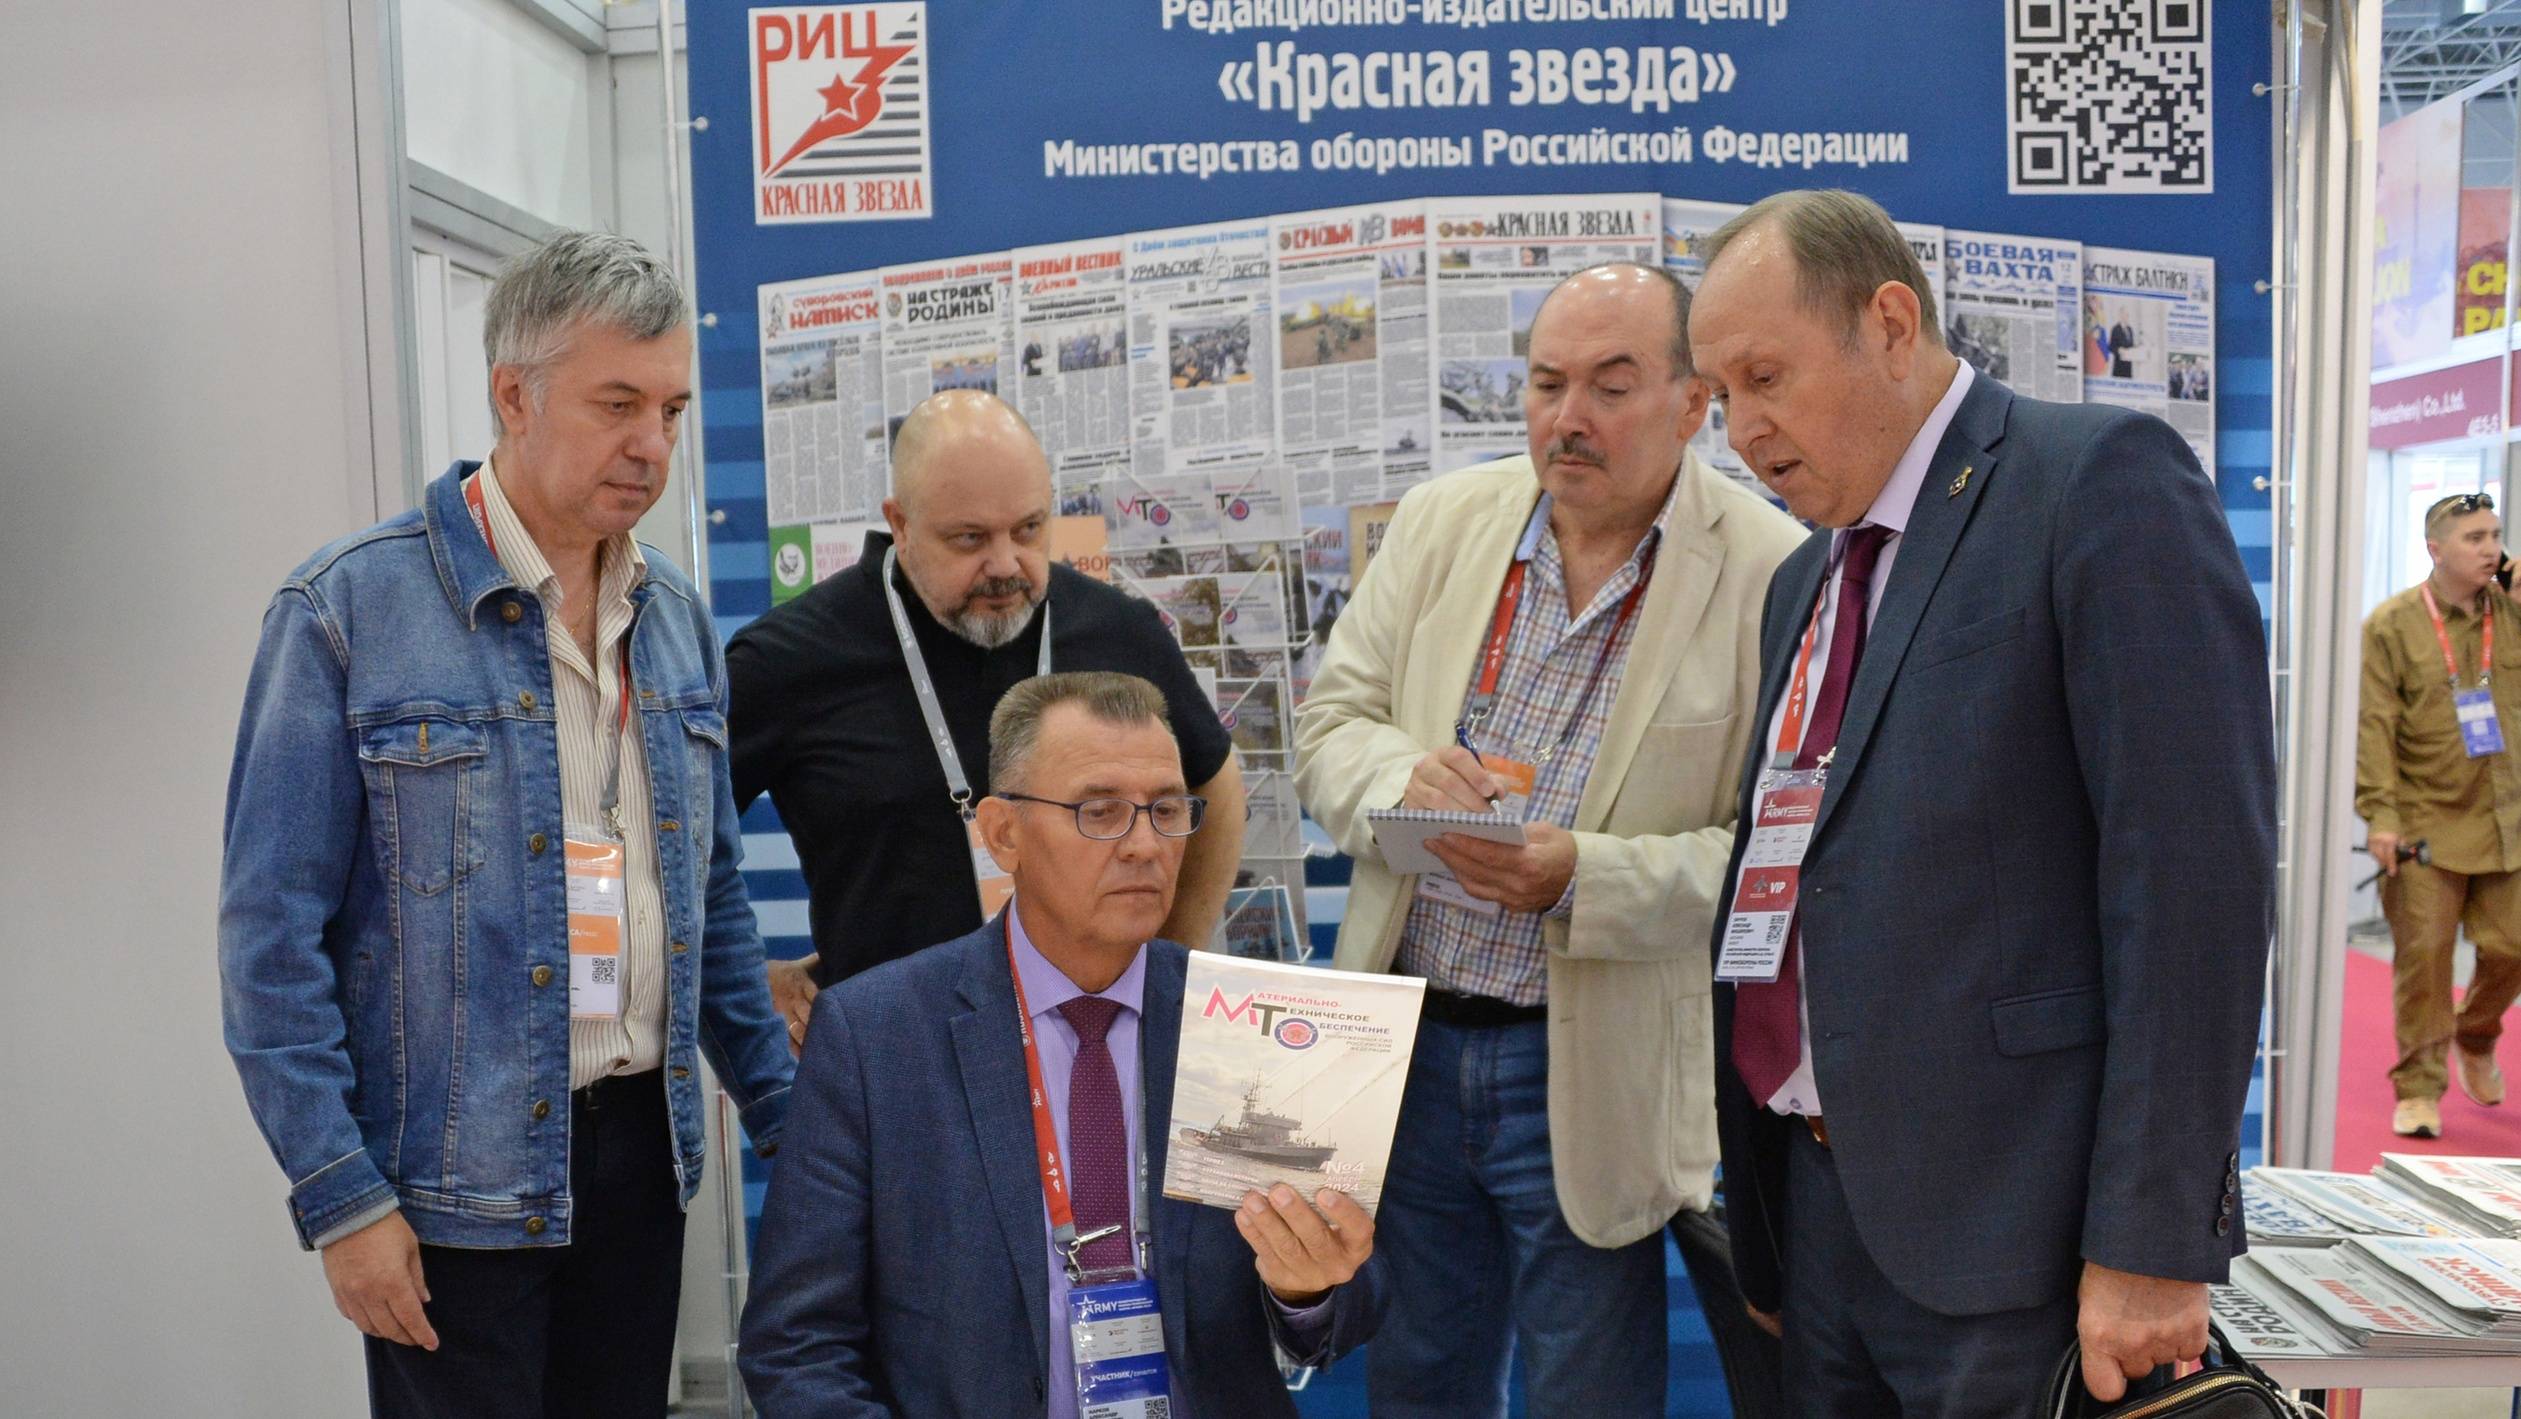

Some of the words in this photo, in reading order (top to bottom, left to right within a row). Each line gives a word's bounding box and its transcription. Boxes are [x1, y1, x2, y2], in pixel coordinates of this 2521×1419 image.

[1686, 0, 1789, 26] центр
[1217, 40, 1491, 123] «Красная
[1508, 46, 1738, 113] звезда»
[1043, 139, 1300, 179] Министерства
[1311, 132, 1472, 175] обороны
[1482, 127, 1694, 166] Российской
[1702, 126, 1909, 169] Федерации
[762, 180, 846, 216] КРАСНАЯ
[854, 178, 924, 213] ЗВЕЗДА
[1496, 211, 1570, 238] КРАСНАЯ
[1577, 209, 1636, 236] ЗВЕЗДА
[1945, 240, 2054, 264] БОЕВАЯ
[1964, 260, 2054, 283] ВАХТА
[907, 297, 995, 323] РОДИНЫ
[1770, 881, 1787, 895] VIP
[1079, 1296, 1119, 1315] ARMY
